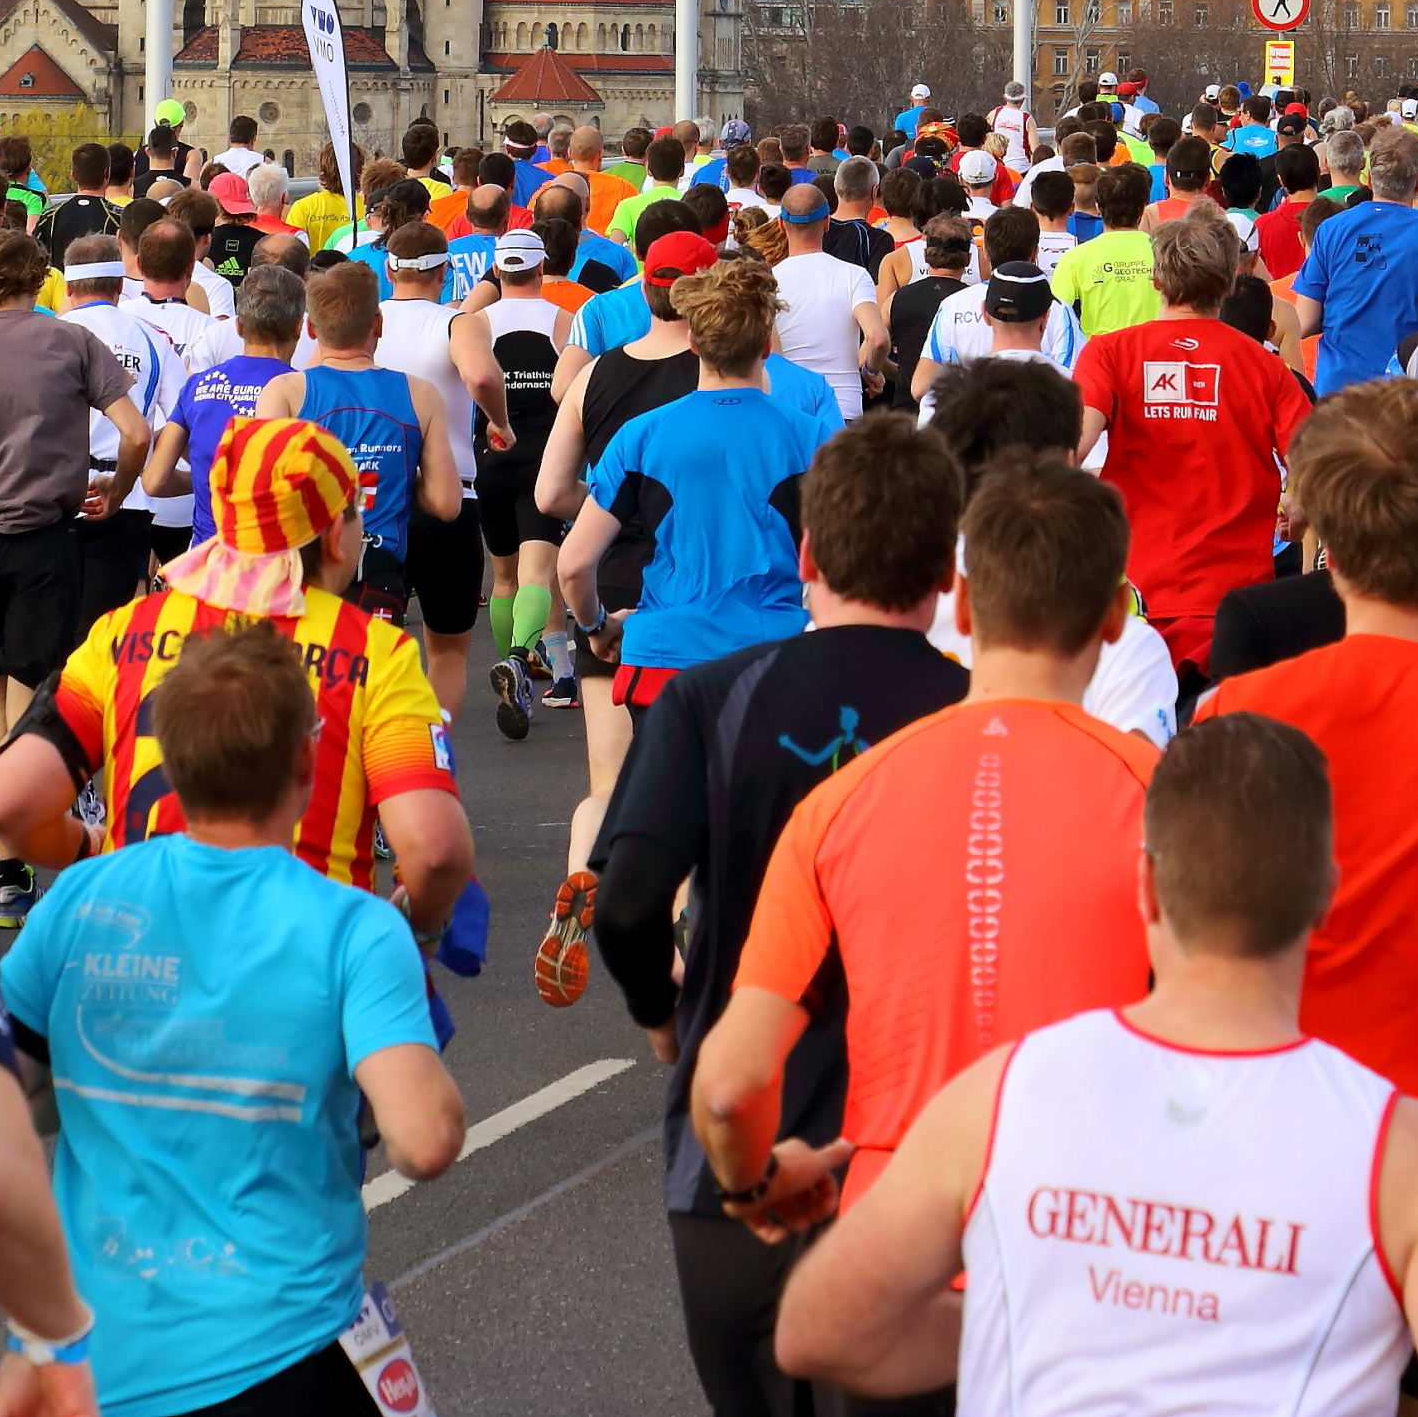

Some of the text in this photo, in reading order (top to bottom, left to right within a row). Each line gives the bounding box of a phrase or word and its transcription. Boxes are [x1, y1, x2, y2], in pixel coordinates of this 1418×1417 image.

[214, 265, 244, 277] adidas
[1113, 259, 1147, 269] GRUPPE
[1114, 275, 1137, 283] GRAZ
[195, 384, 209, 396] WE
[209, 383, 232, 394] ARE
[1150, 372, 1179, 392] AK
[1143, 405, 1171, 419] LETS
[1194, 407, 1218, 422] FAIR
[359, 443, 402, 453] Runners
[83, 953, 180, 982] KLEINE
[1026, 1184, 1308, 1278] GENERALI
[1087, 1263, 1220, 1323] Vienna
